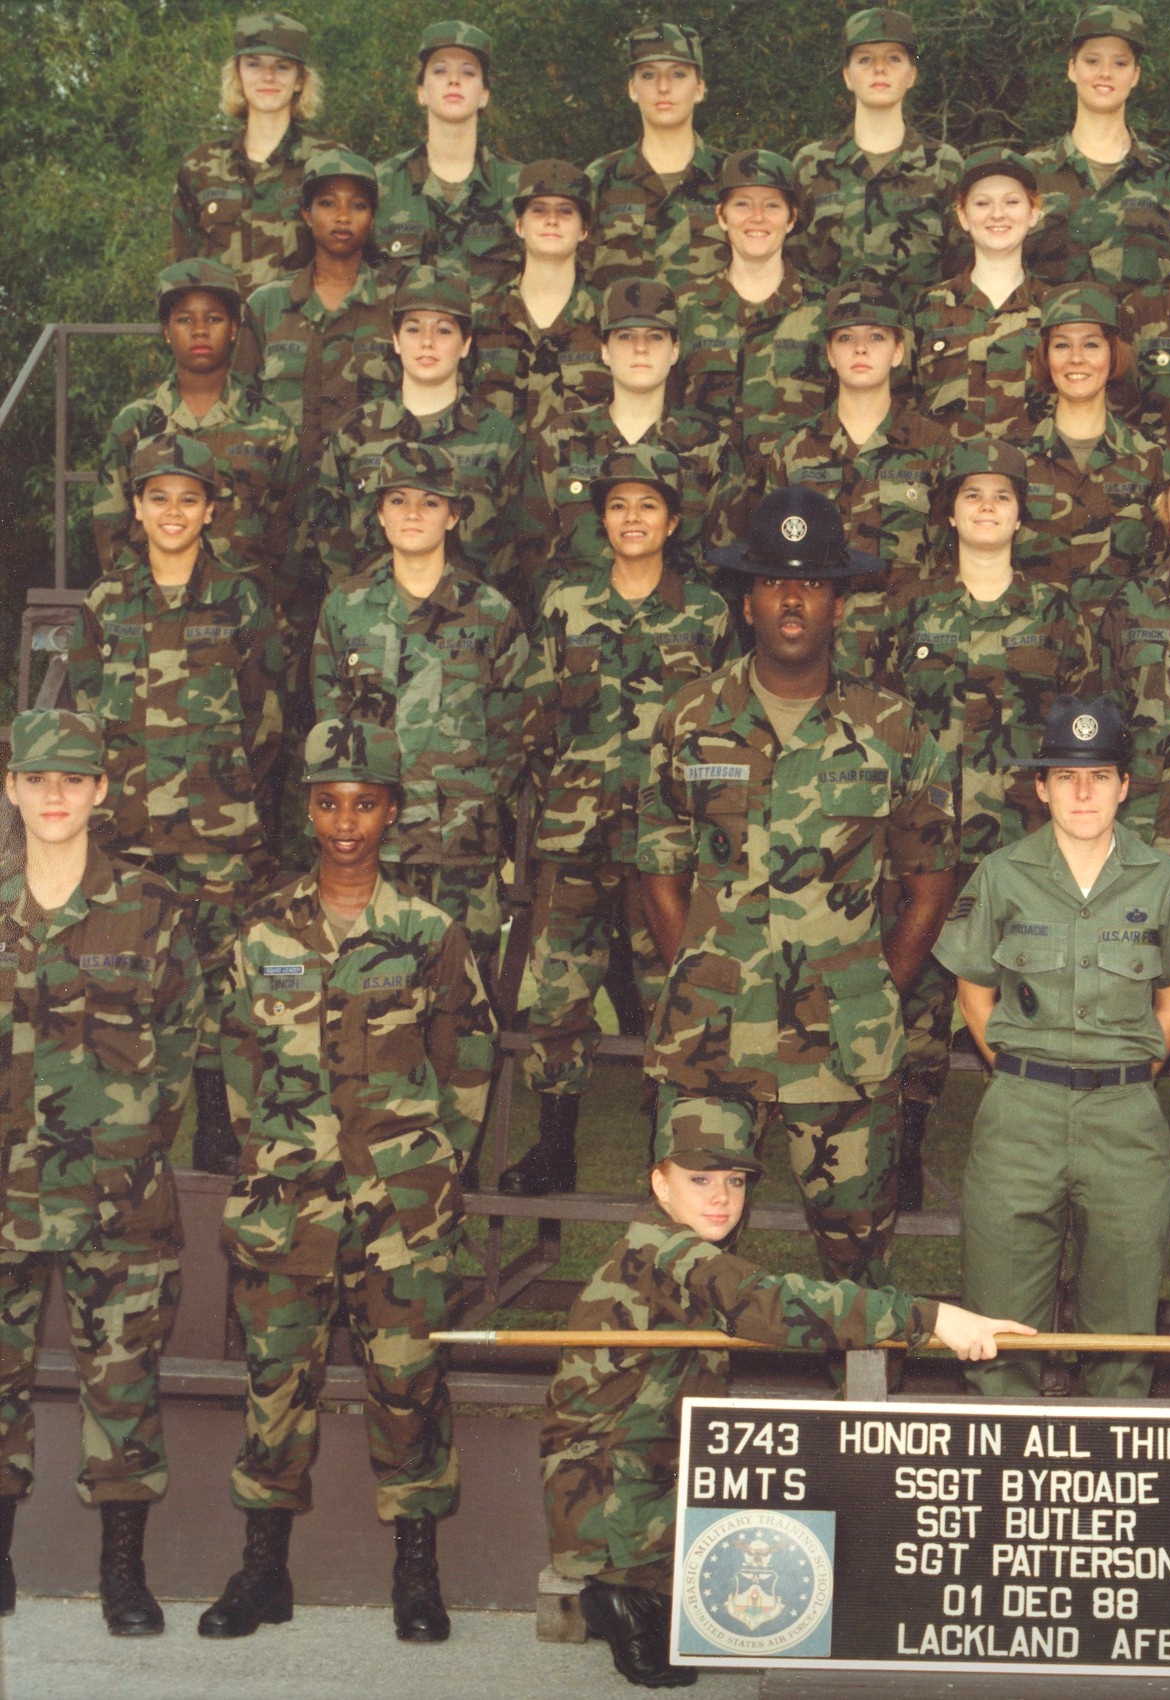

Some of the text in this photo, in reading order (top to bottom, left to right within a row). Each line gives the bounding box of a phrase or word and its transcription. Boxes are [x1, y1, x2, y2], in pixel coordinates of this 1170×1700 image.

[688, 767, 741, 779] PATTERSON
[708, 1422, 798, 1455] 3743
[839, 1421, 950, 1455] HONOR
[969, 1424, 1001, 1455] IN
[1024, 1425, 1090, 1457] ALL
[694, 1467, 805, 1500] BMTS
[896, 1467, 1159, 1504] SSGT BYROADE
[918, 1506, 1136, 1541] SGT BUTLER
[686, 1515, 829, 1608] BASIC MILITARY TRAINING SCHOOL
[896, 1543, 969, 1575] SGT
[944, 1585, 1137, 1620] 01 DEC 88
[728, 1637, 765, 1648] STATES
[768, 1634, 786, 1648] AIR
[897, 1624, 1078, 1657] LACKLAND
